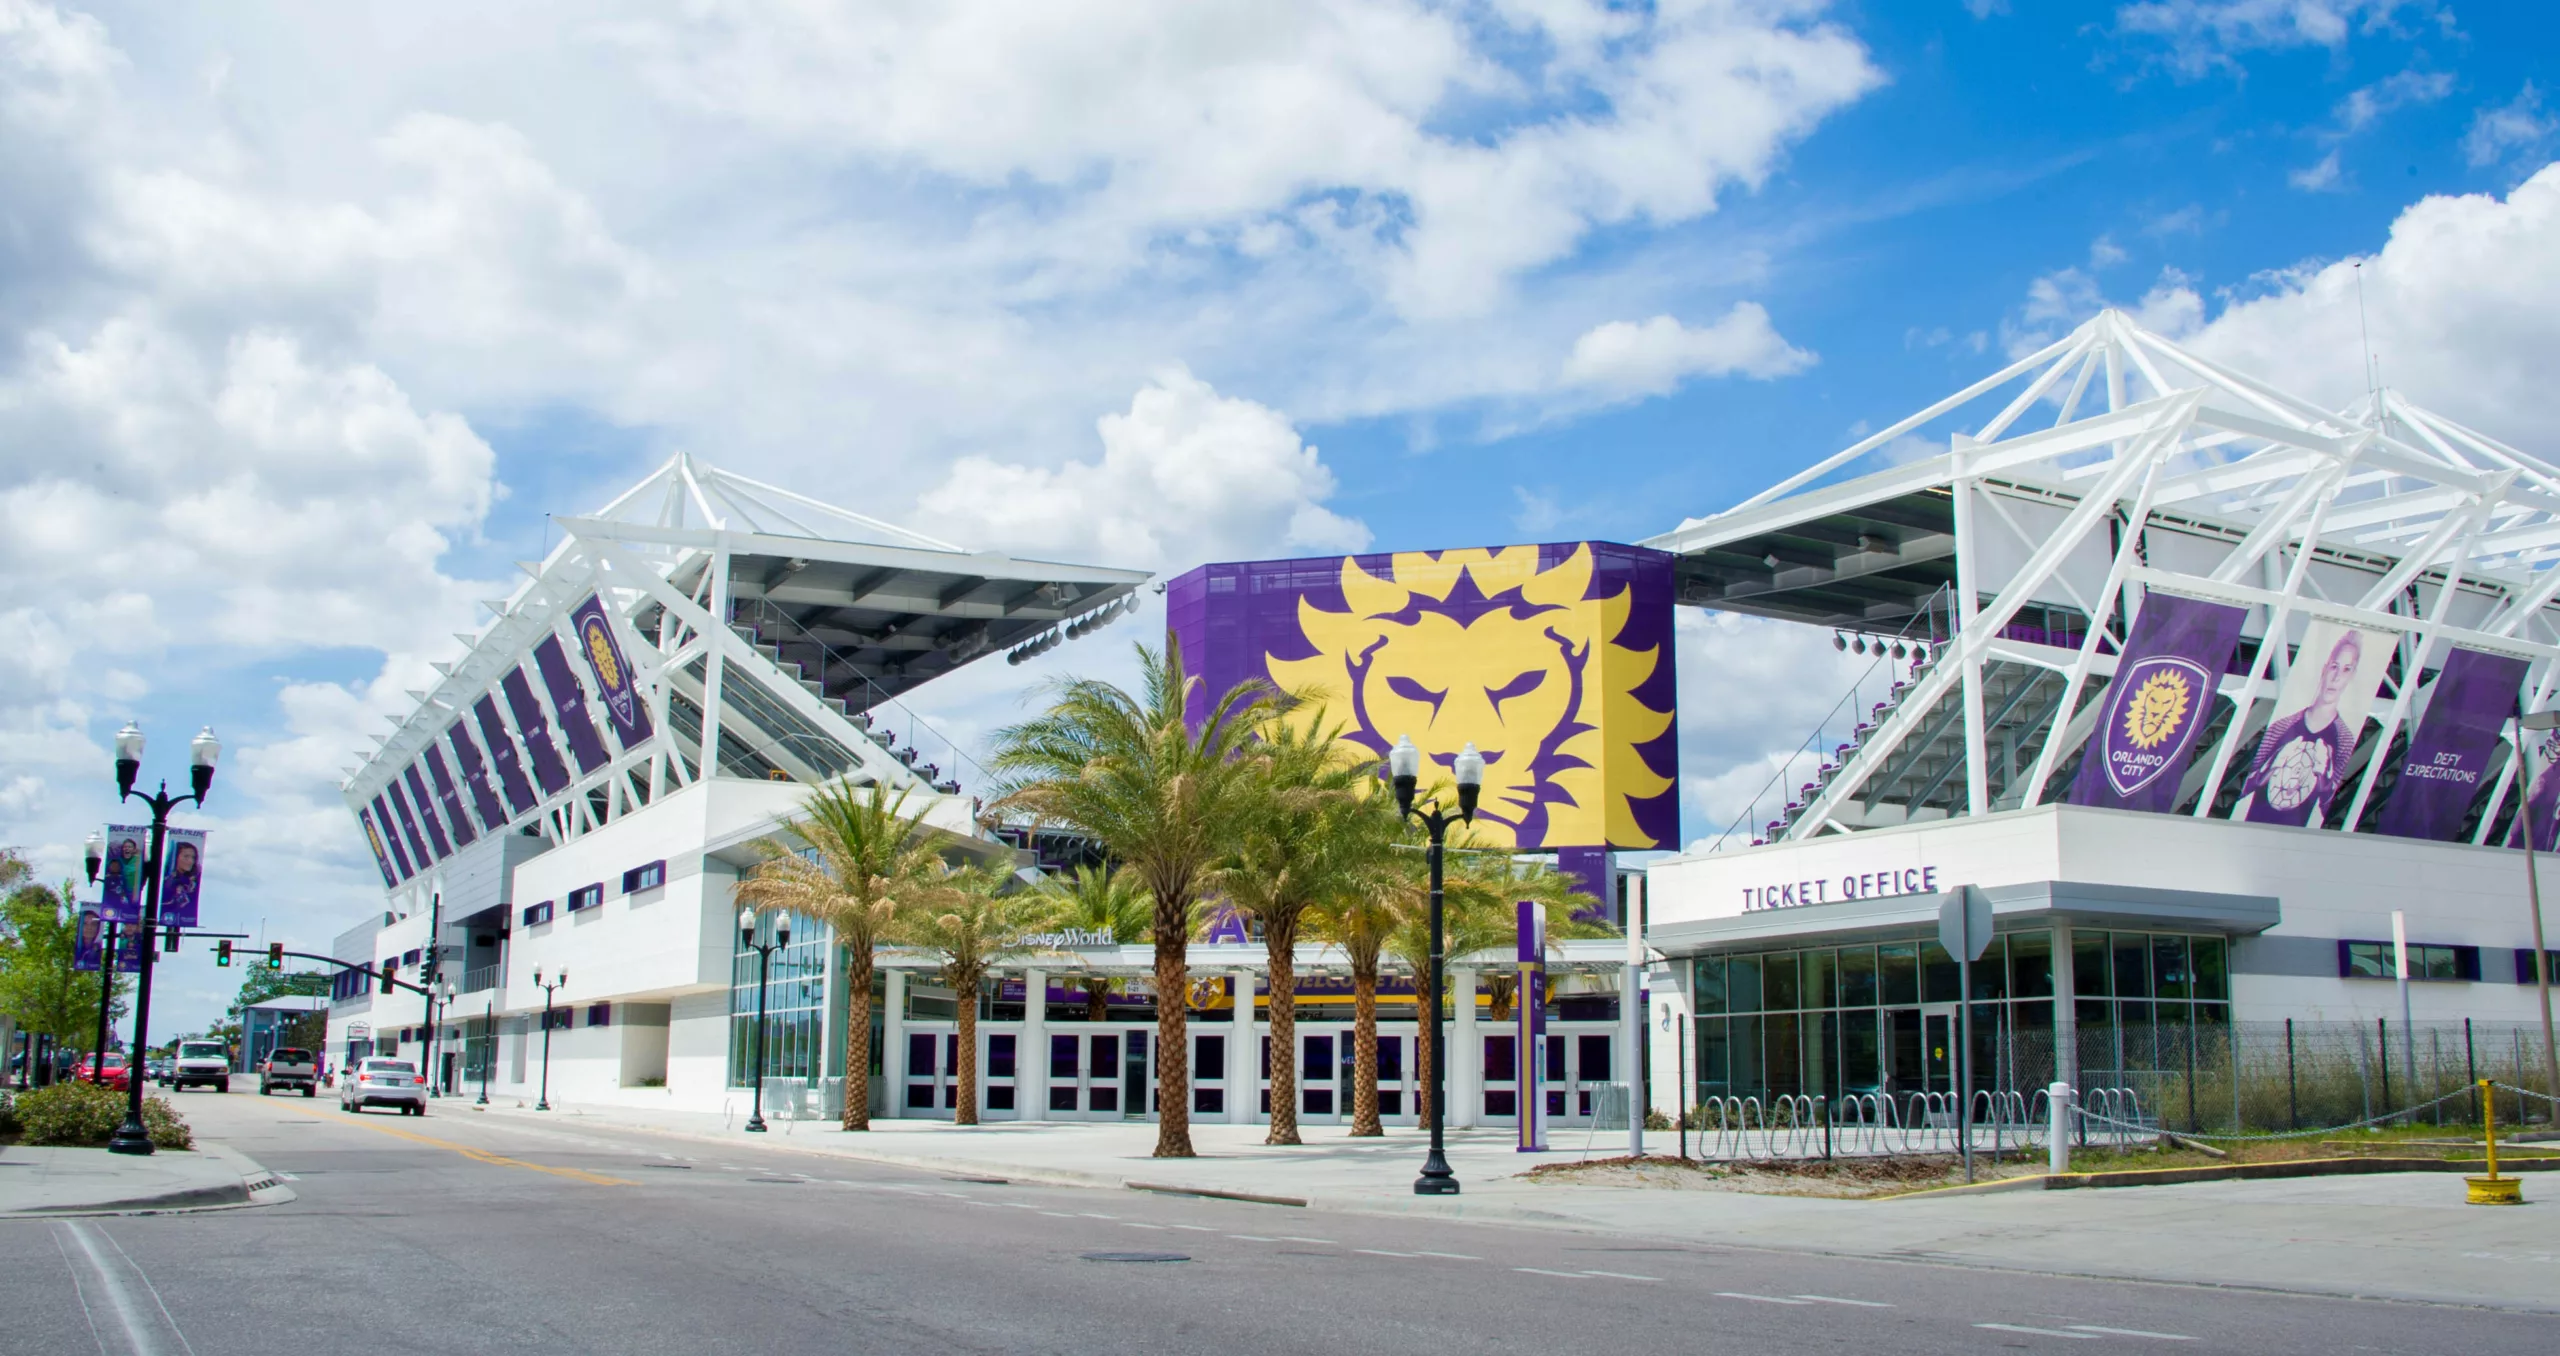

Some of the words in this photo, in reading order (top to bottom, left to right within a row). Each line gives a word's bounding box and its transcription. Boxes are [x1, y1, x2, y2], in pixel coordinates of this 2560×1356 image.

[2112, 750, 2164, 767] ORLANDO
[2433, 751, 2462, 767] DEFY
[2121, 764, 2146, 777] CITY
[2405, 763, 2477, 783] EXPECTATIONS
[1742, 879, 1828, 909] TICKET
[1842, 866, 1937, 899] OFFICE
[1209, 897, 1248, 945] A
